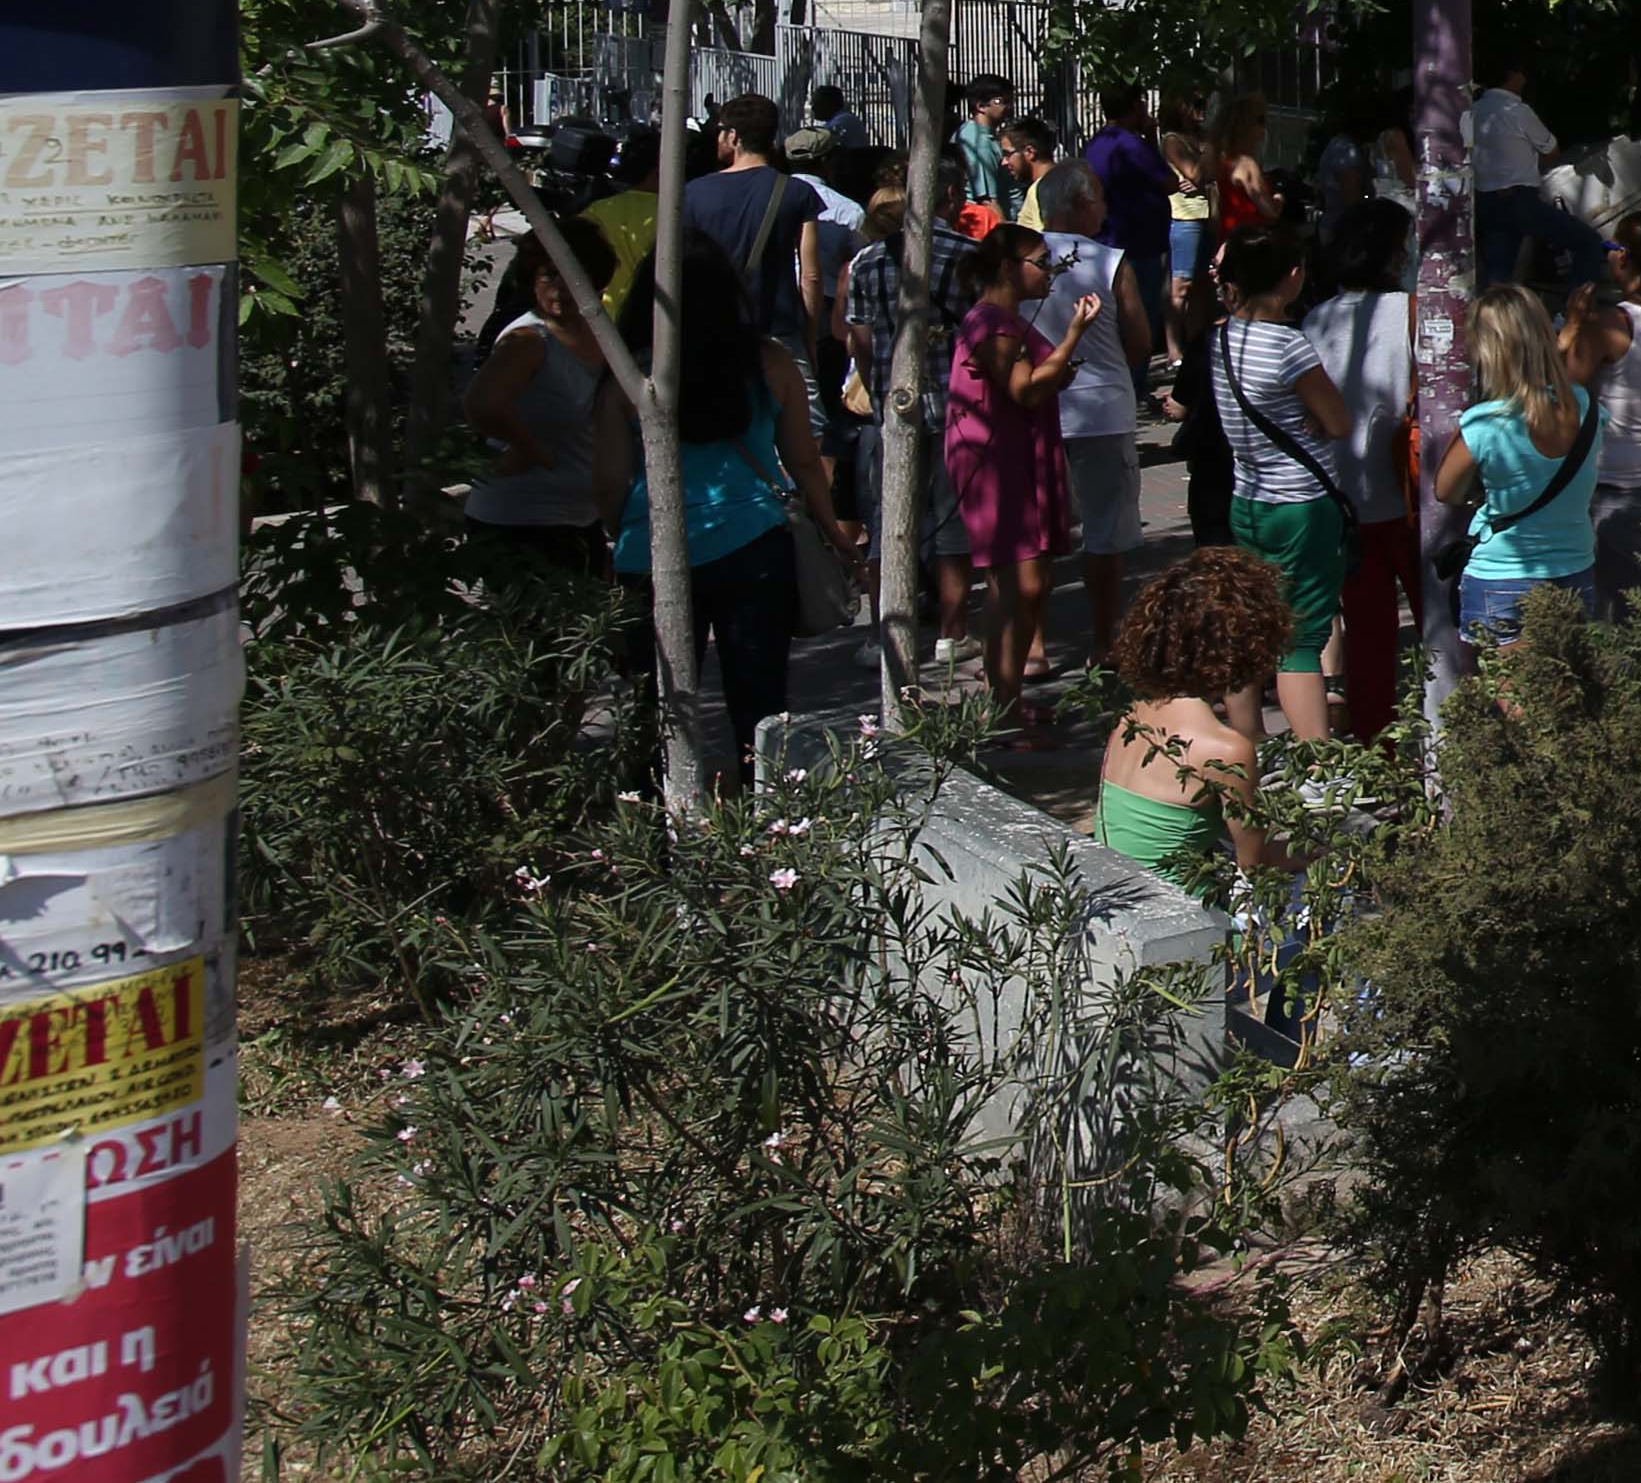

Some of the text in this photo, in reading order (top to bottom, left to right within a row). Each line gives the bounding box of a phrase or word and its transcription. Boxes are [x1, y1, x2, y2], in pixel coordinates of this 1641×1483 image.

[29, 950, 81, 973] 210
[124, 1216, 214, 1278] είναι
[9, 1324, 156, 1400] και η
[0, 1356, 214, 1482] δουλειά
